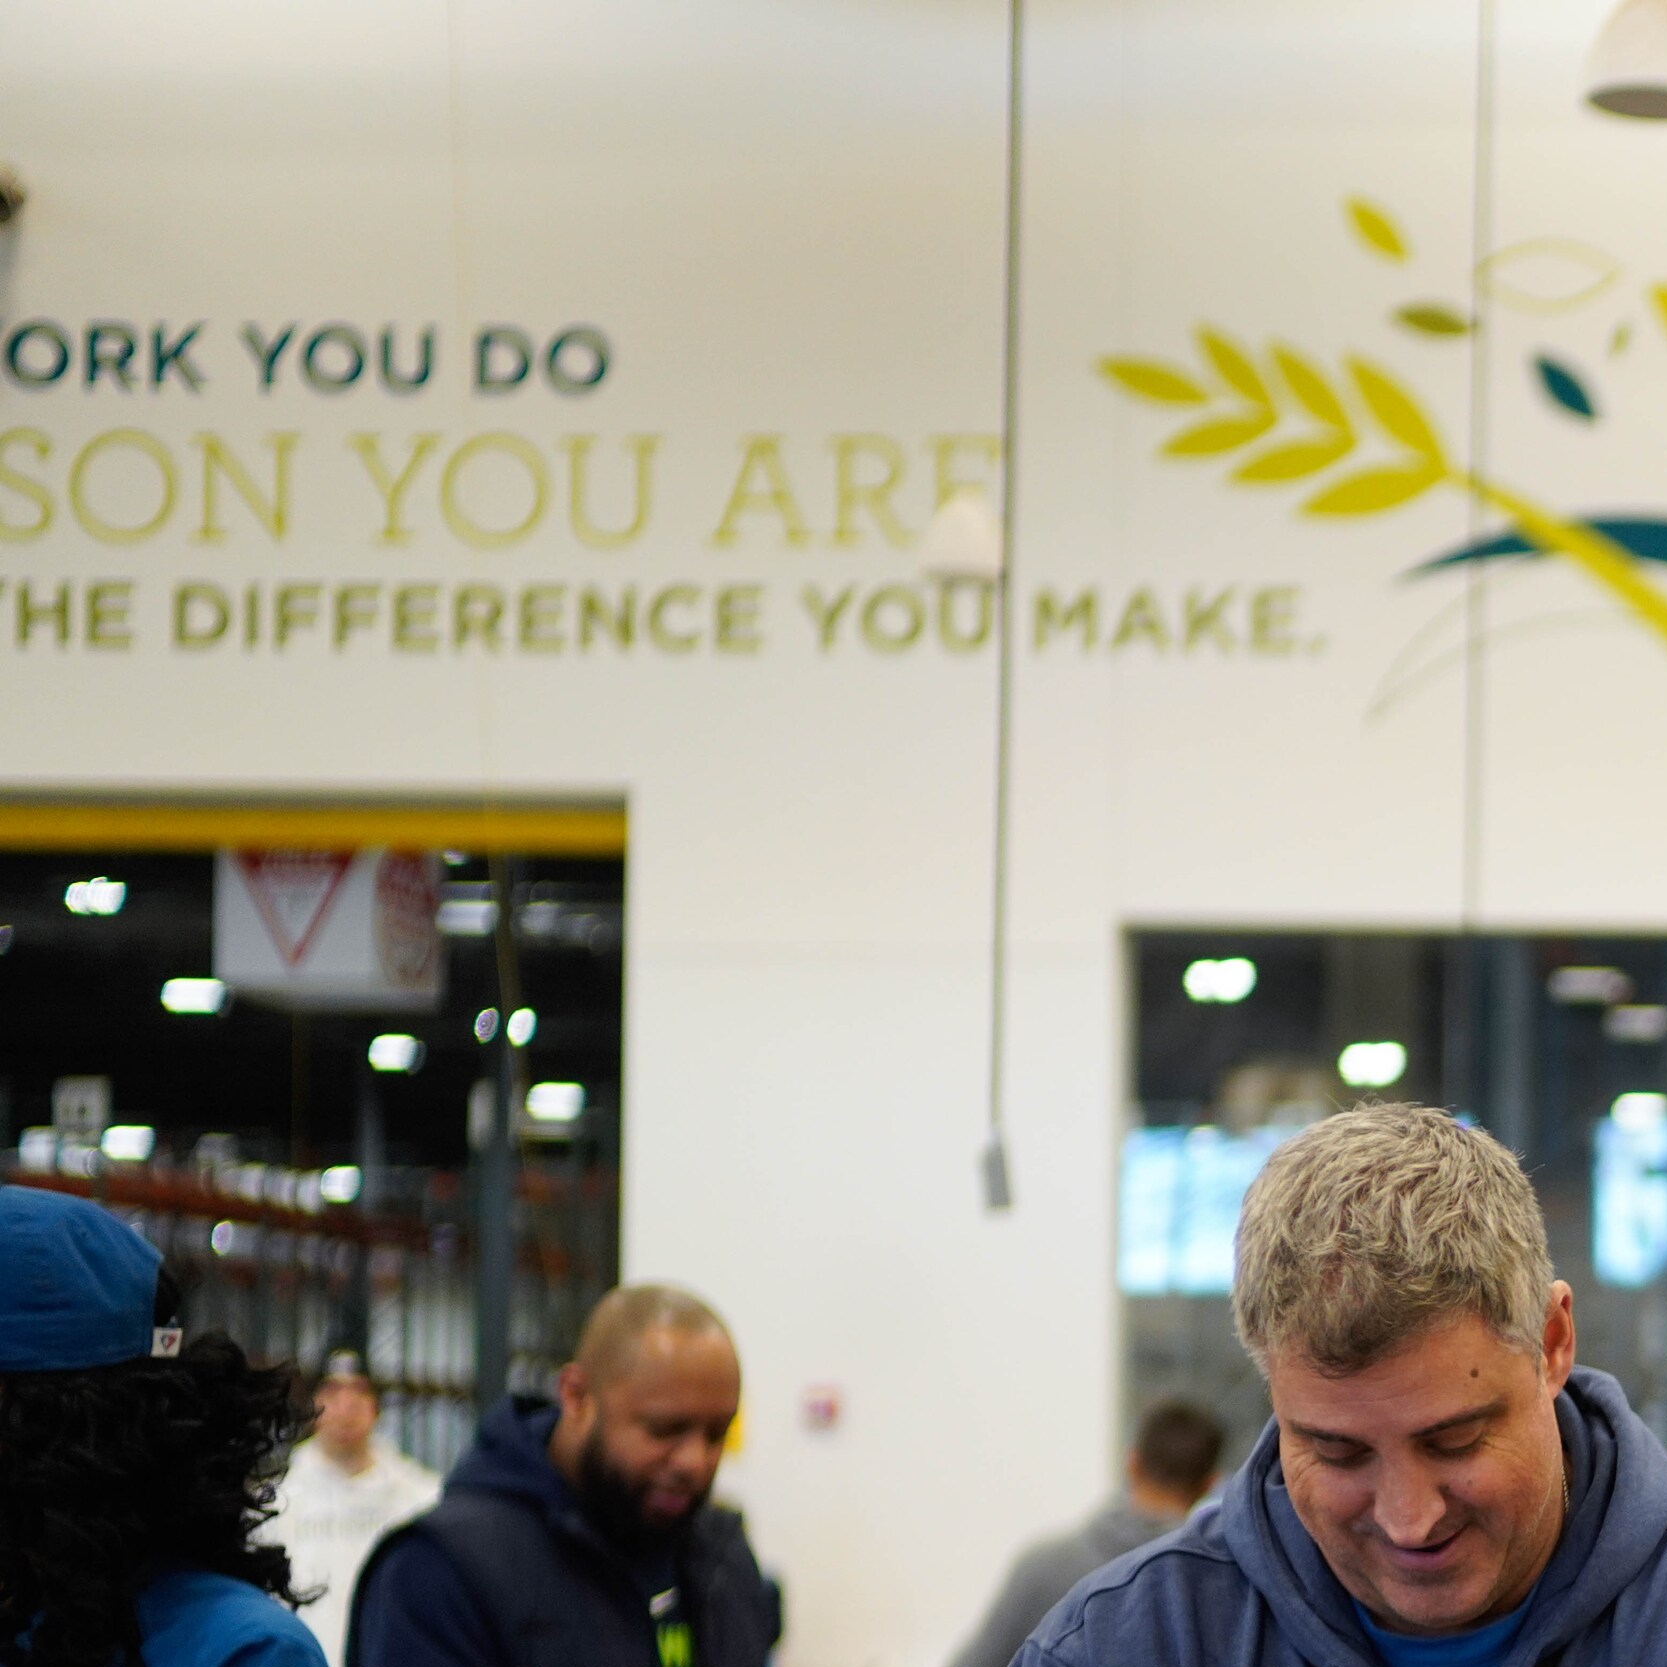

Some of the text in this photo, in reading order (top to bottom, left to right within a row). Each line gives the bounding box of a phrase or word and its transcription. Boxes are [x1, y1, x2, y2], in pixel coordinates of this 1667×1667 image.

[0, 318, 613, 395] ORK YOU DO
[345, 428, 664, 550] YOU
[0, 577, 1330, 657] HE DIFFERENCE YOU MAKE.
